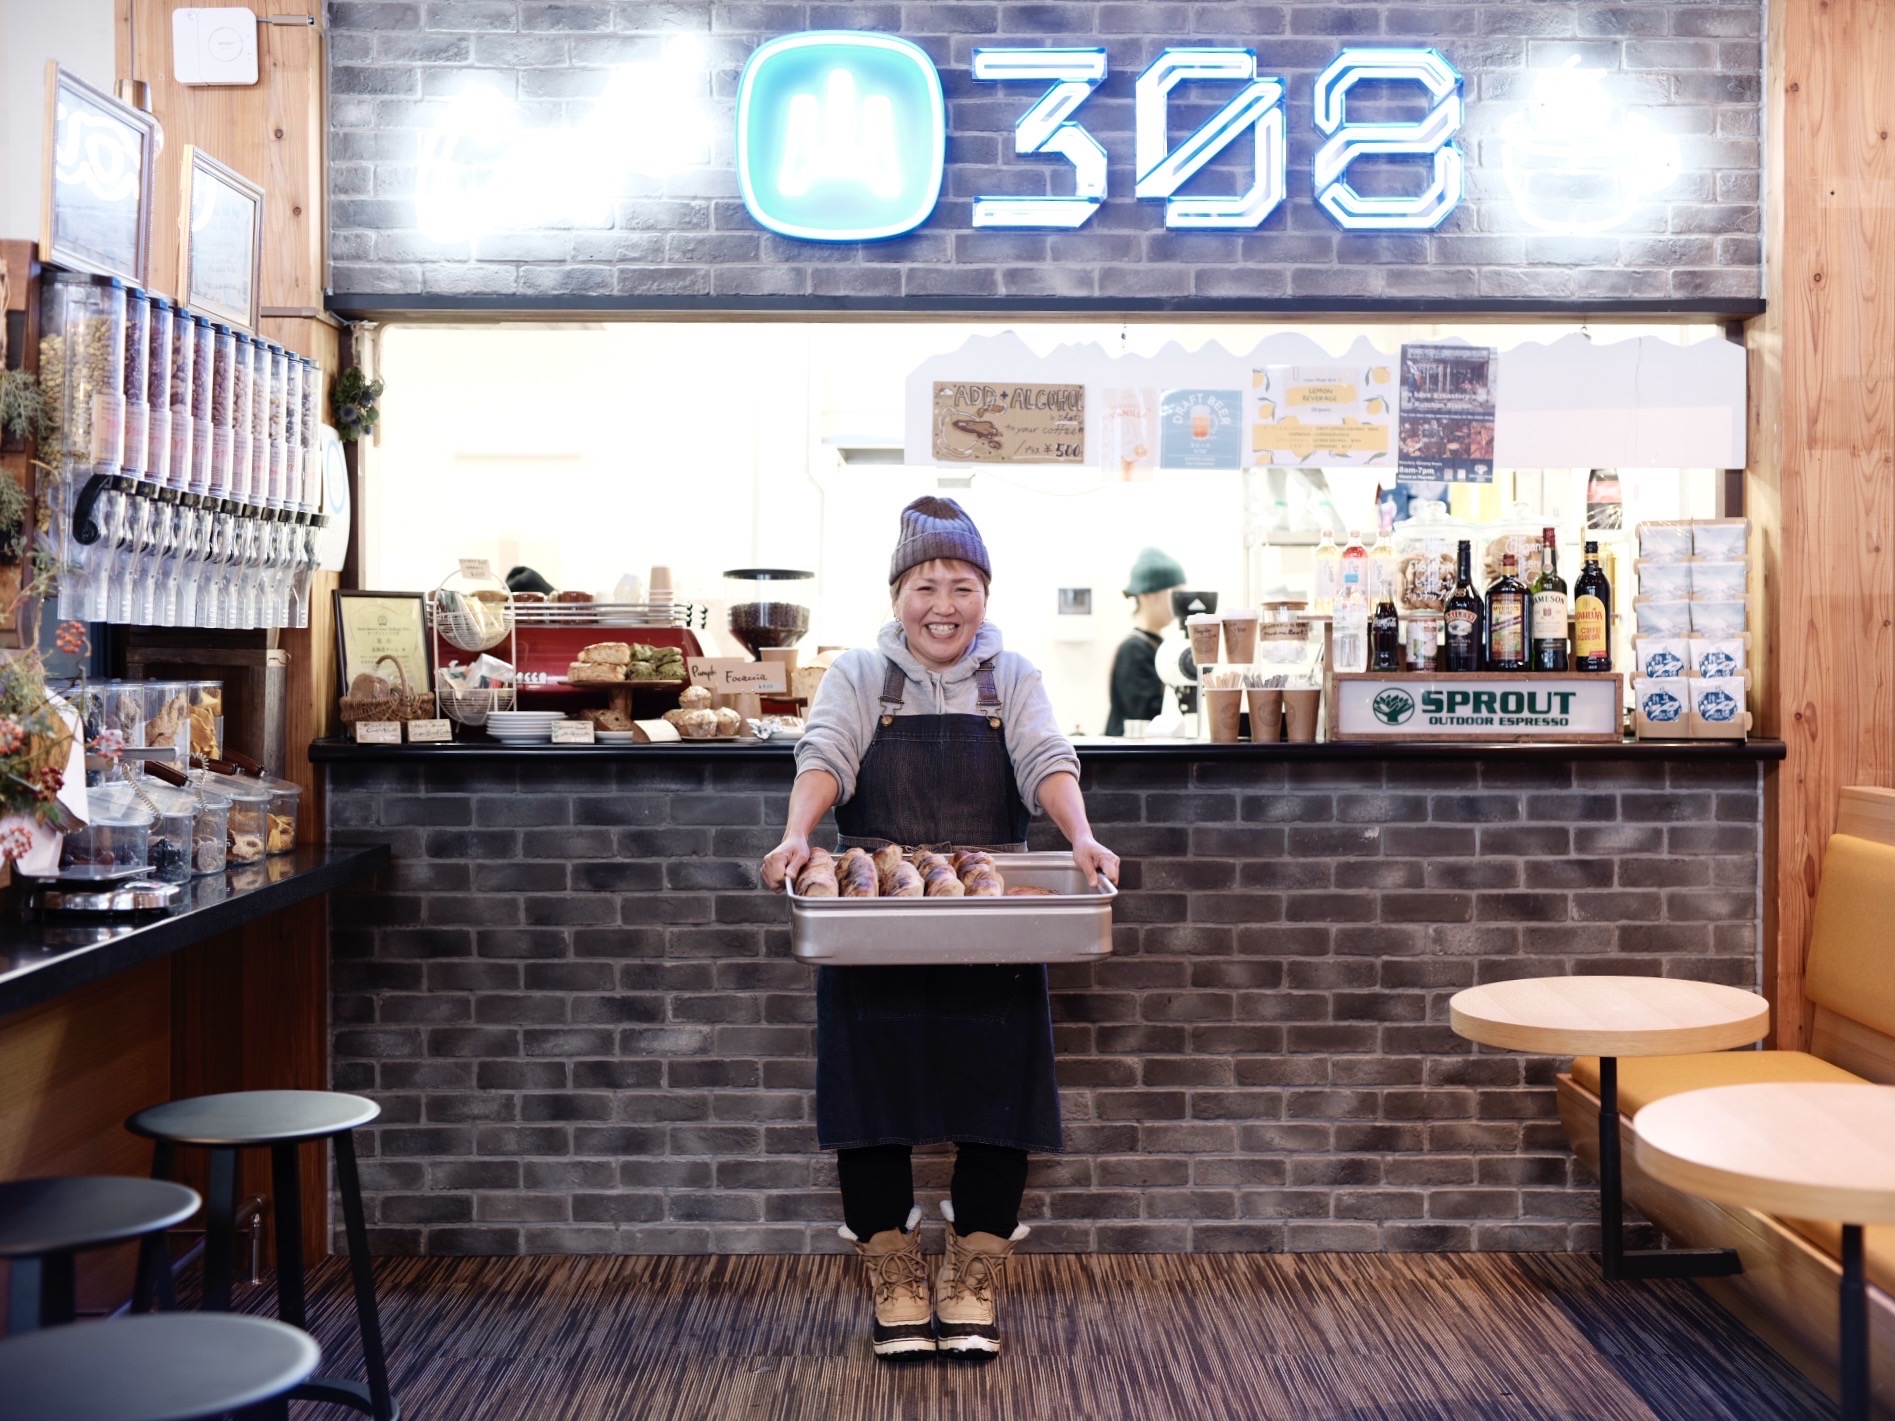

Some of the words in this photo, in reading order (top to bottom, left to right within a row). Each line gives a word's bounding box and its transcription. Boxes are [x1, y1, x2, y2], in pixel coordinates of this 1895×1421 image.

[954, 385, 997, 407] ADD
[1010, 387, 1084, 411] ALCOHOL
[1172, 393, 1204, 424] DRAFT
[1207, 395, 1231, 426] BEER
[1016, 425, 1039, 435] your
[1399, 466, 1435, 475] 8am-7pm
[725, 670, 768, 683] Focaccia
[1422, 690, 1577, 715] SPROUT
[1428, 716, 1494, 726] OUTDOOR
[1499, 716, 1569, 726] ESPRESSO
